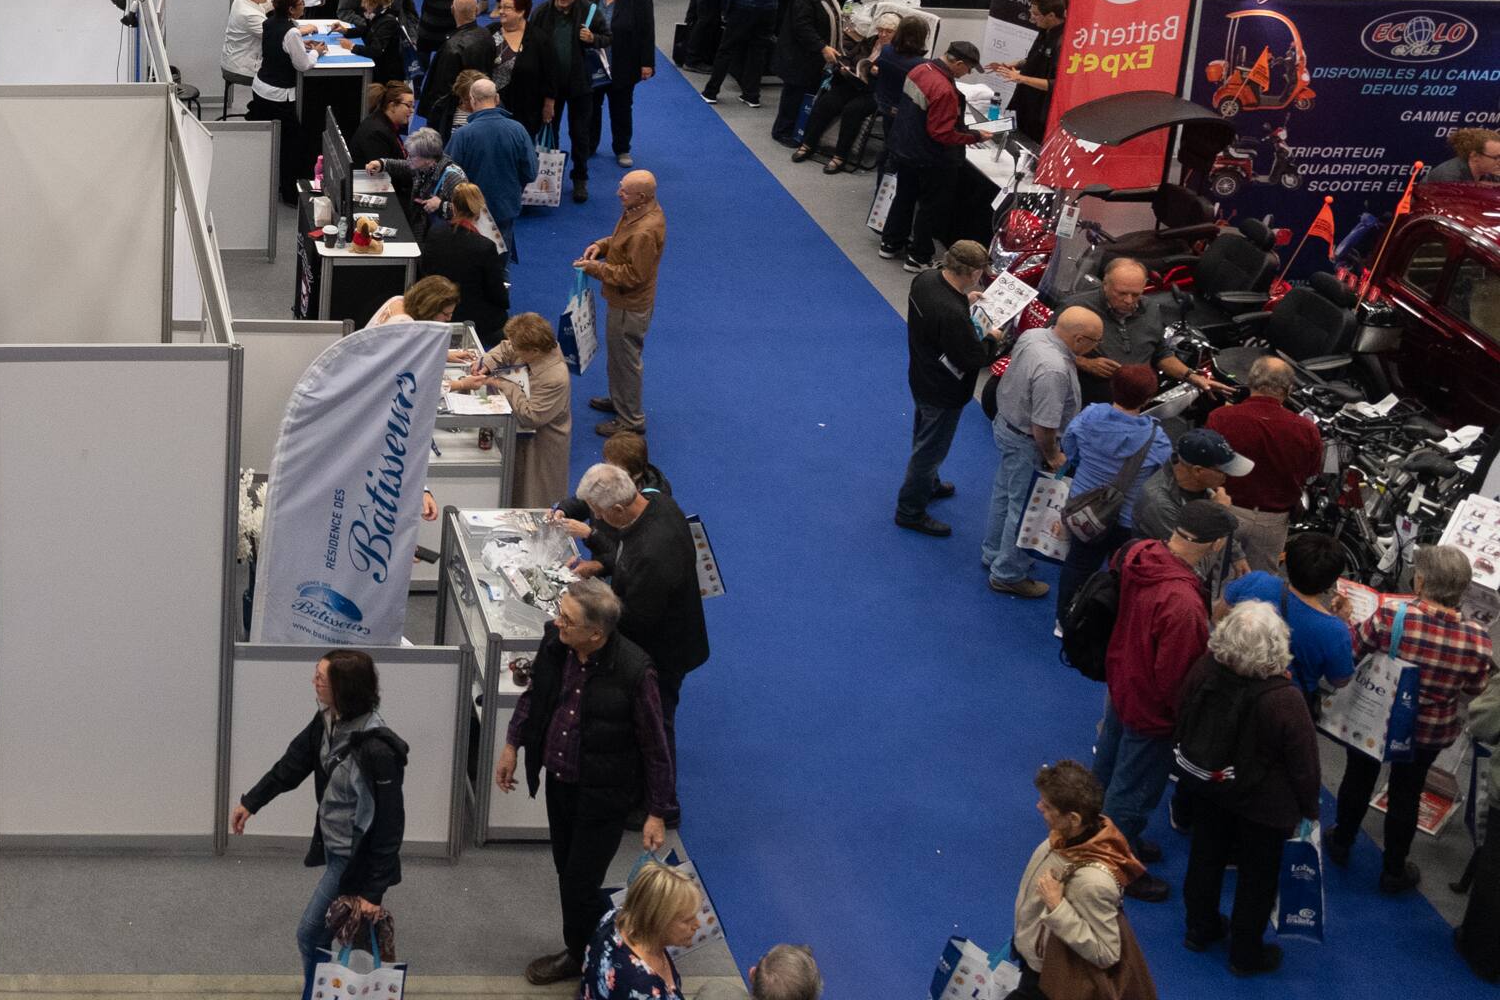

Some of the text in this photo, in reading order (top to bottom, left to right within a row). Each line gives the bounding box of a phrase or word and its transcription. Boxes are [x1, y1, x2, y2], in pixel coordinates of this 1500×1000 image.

[1391, 44, 1442, 56] CYCLE
[1312, 67, 1500, 81] DISPONIBLES AU CANAD
[1361, 83, 1458, 96] DEPUIS 2002
[1400, 110, 1500, 123] GAMME COM
[1287, 146, 1386, 159] TRIPORTEUR
[1297, 163, 1432, 176] QUADRIPORTEUR
[1308, 180, 1381, 192] SCOOTER
[348, 371, 417, 583] Bâtisseurs
[326, 488, 345, 570] RÉSIDENCE DES
[1355, 670, 1386, 697] Lobe
